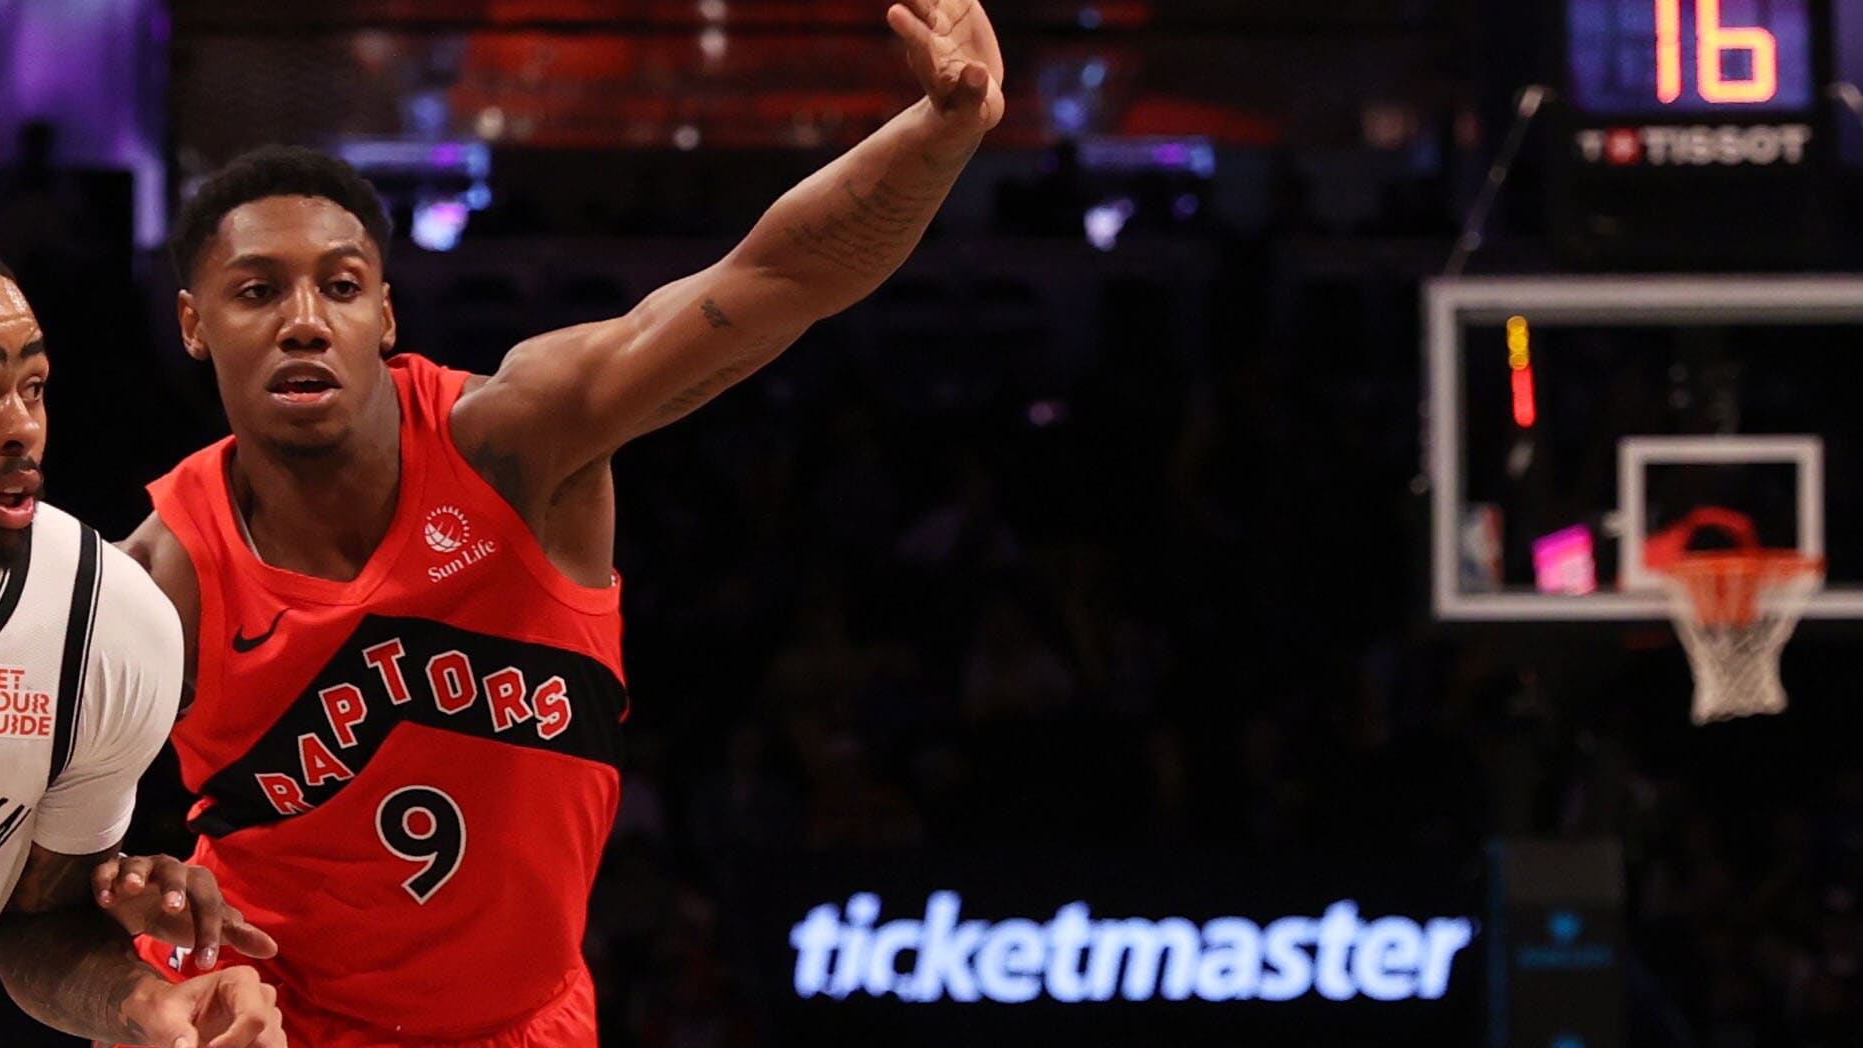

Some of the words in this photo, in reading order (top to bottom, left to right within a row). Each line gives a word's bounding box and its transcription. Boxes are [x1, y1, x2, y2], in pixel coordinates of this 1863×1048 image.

[1654, 0, 1778, 103] 16
[1641, 124, 1811, 165] TISSOT
[427, 559, 465, 583] Sun
[461, 538, 497, 565] Life
[254, 637, 573, 816] RAPTORS
[375, 785, 467, 905] 9
[788, 890, 1473, 1002] ticketmaster
